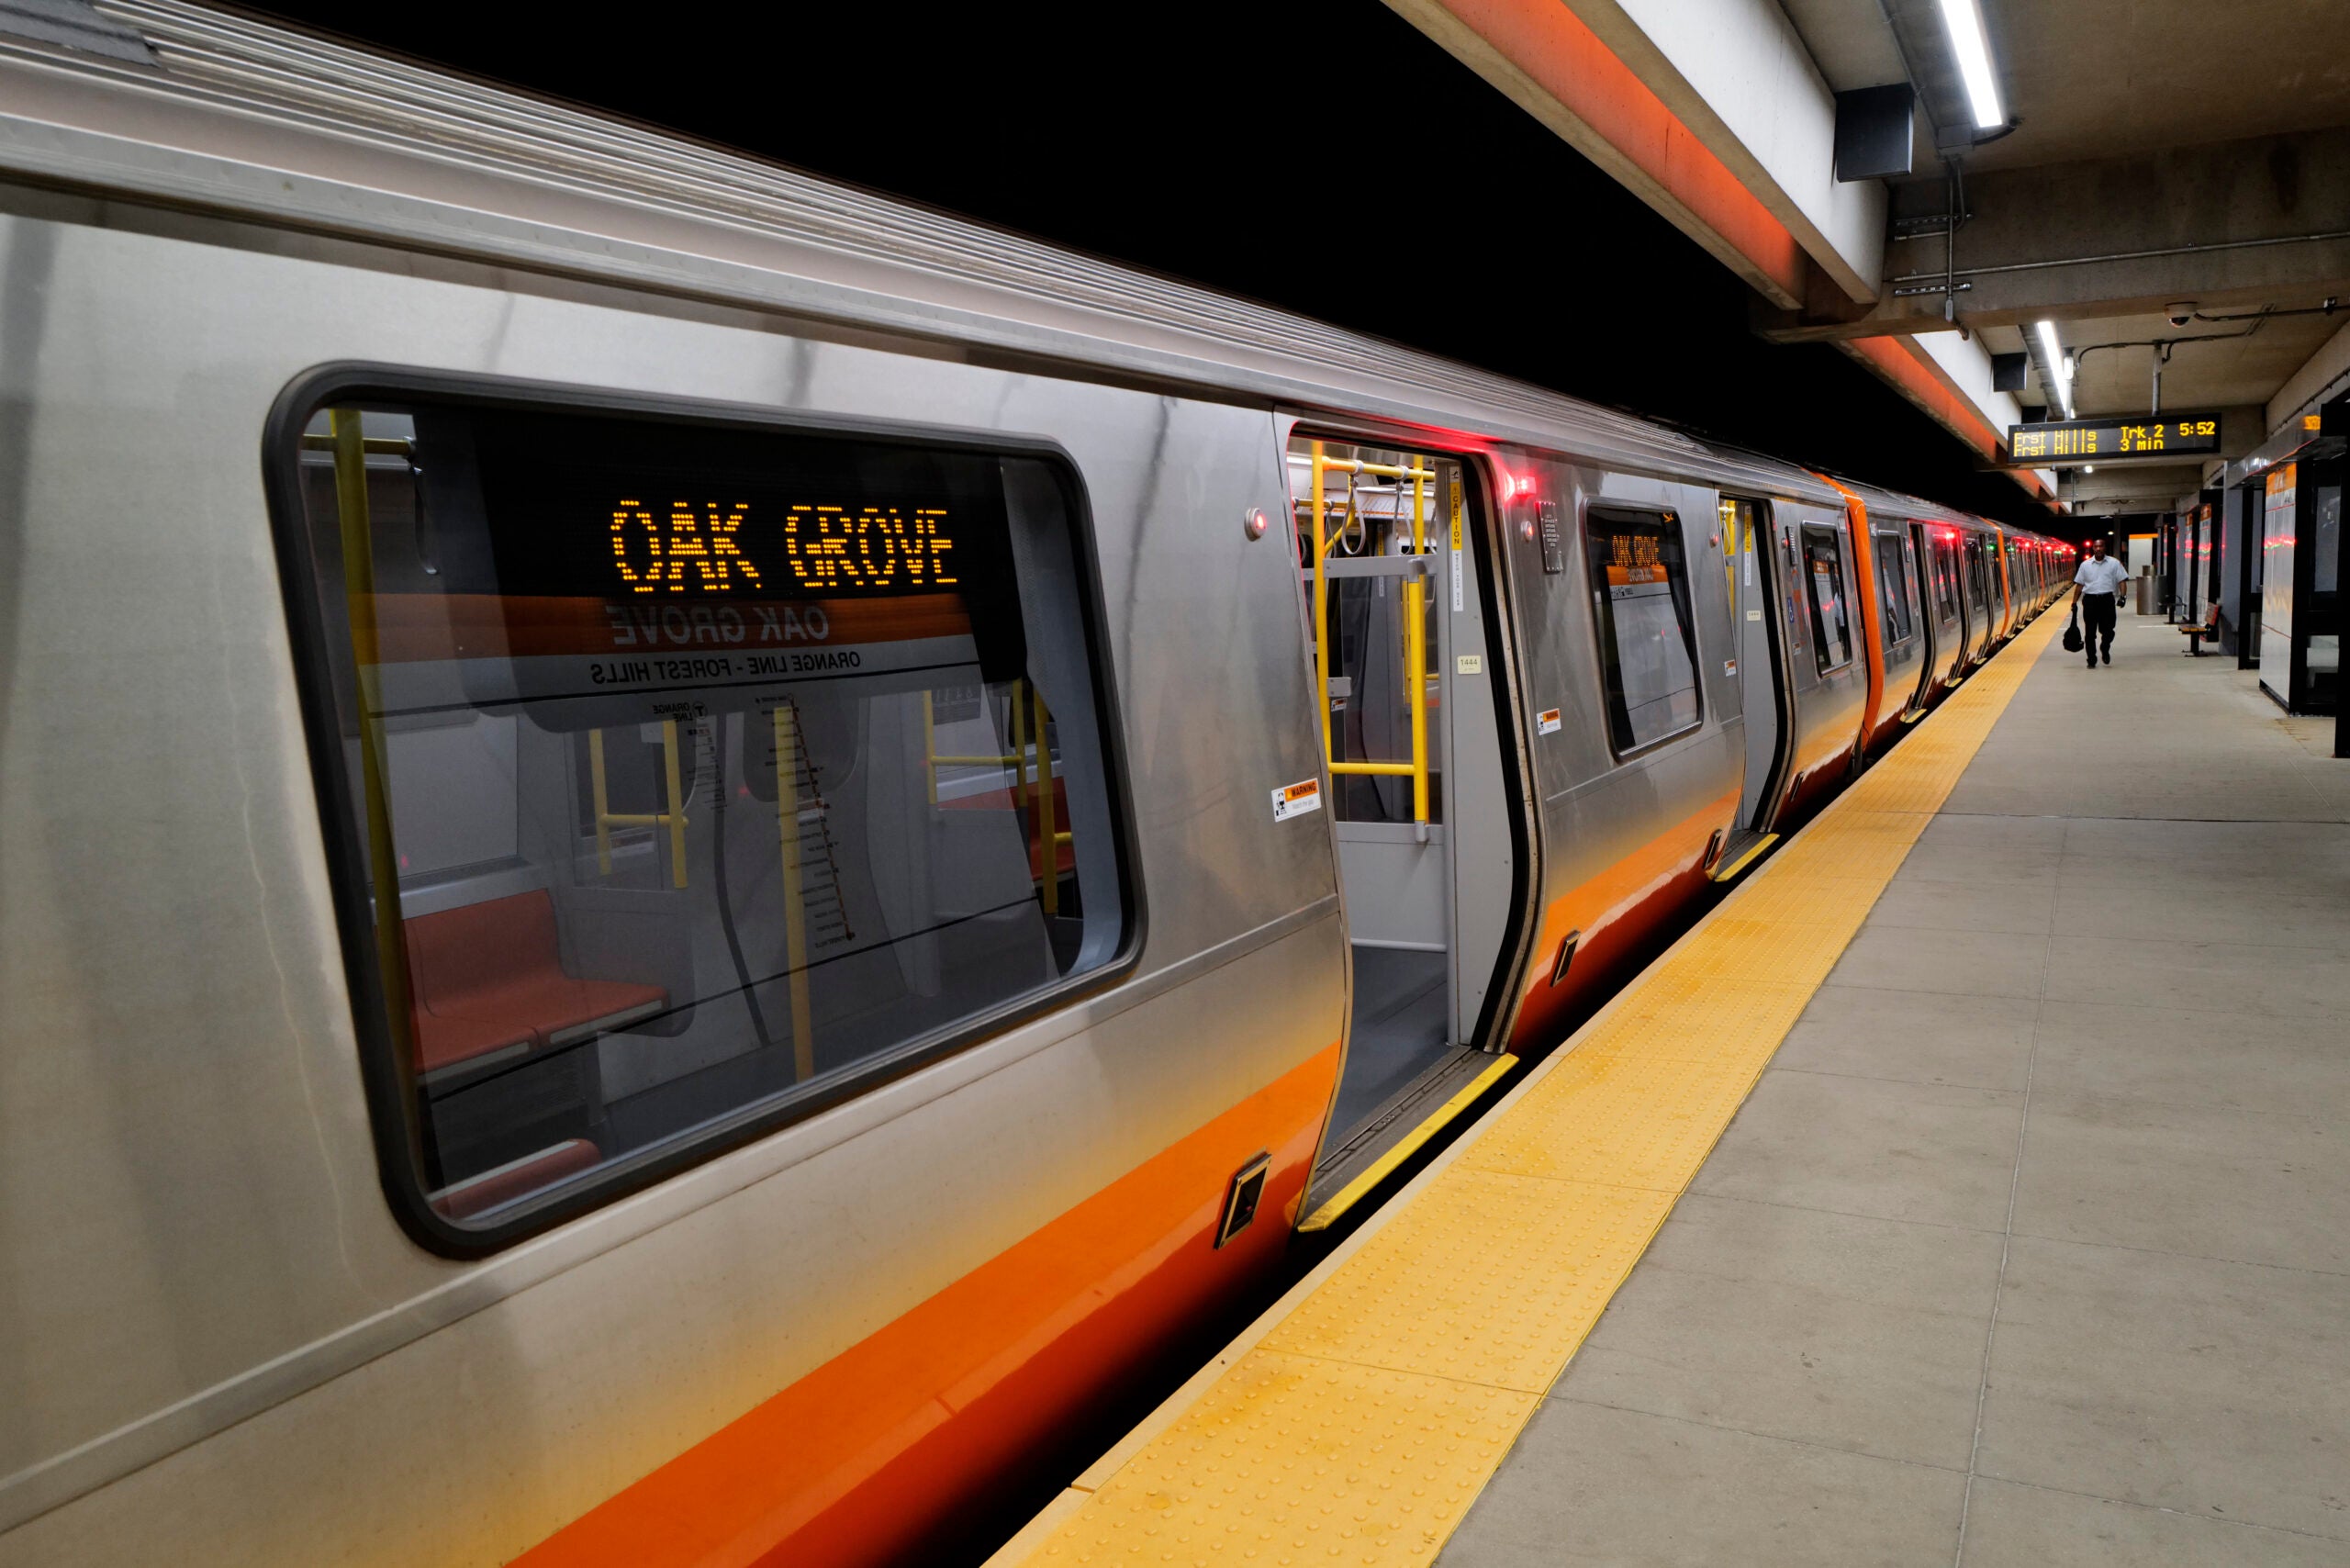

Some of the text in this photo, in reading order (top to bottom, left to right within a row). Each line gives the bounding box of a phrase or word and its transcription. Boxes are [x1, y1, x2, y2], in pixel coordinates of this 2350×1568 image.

[2013, 421, 2215, 444] Frst Hills Trk 2 5:52
[2013, 437, 2164, 457] Frst Hills 3 min
[610, 499, 957, 592] OAK GROVE
[1292, 782, 1316, 797] WARNING
